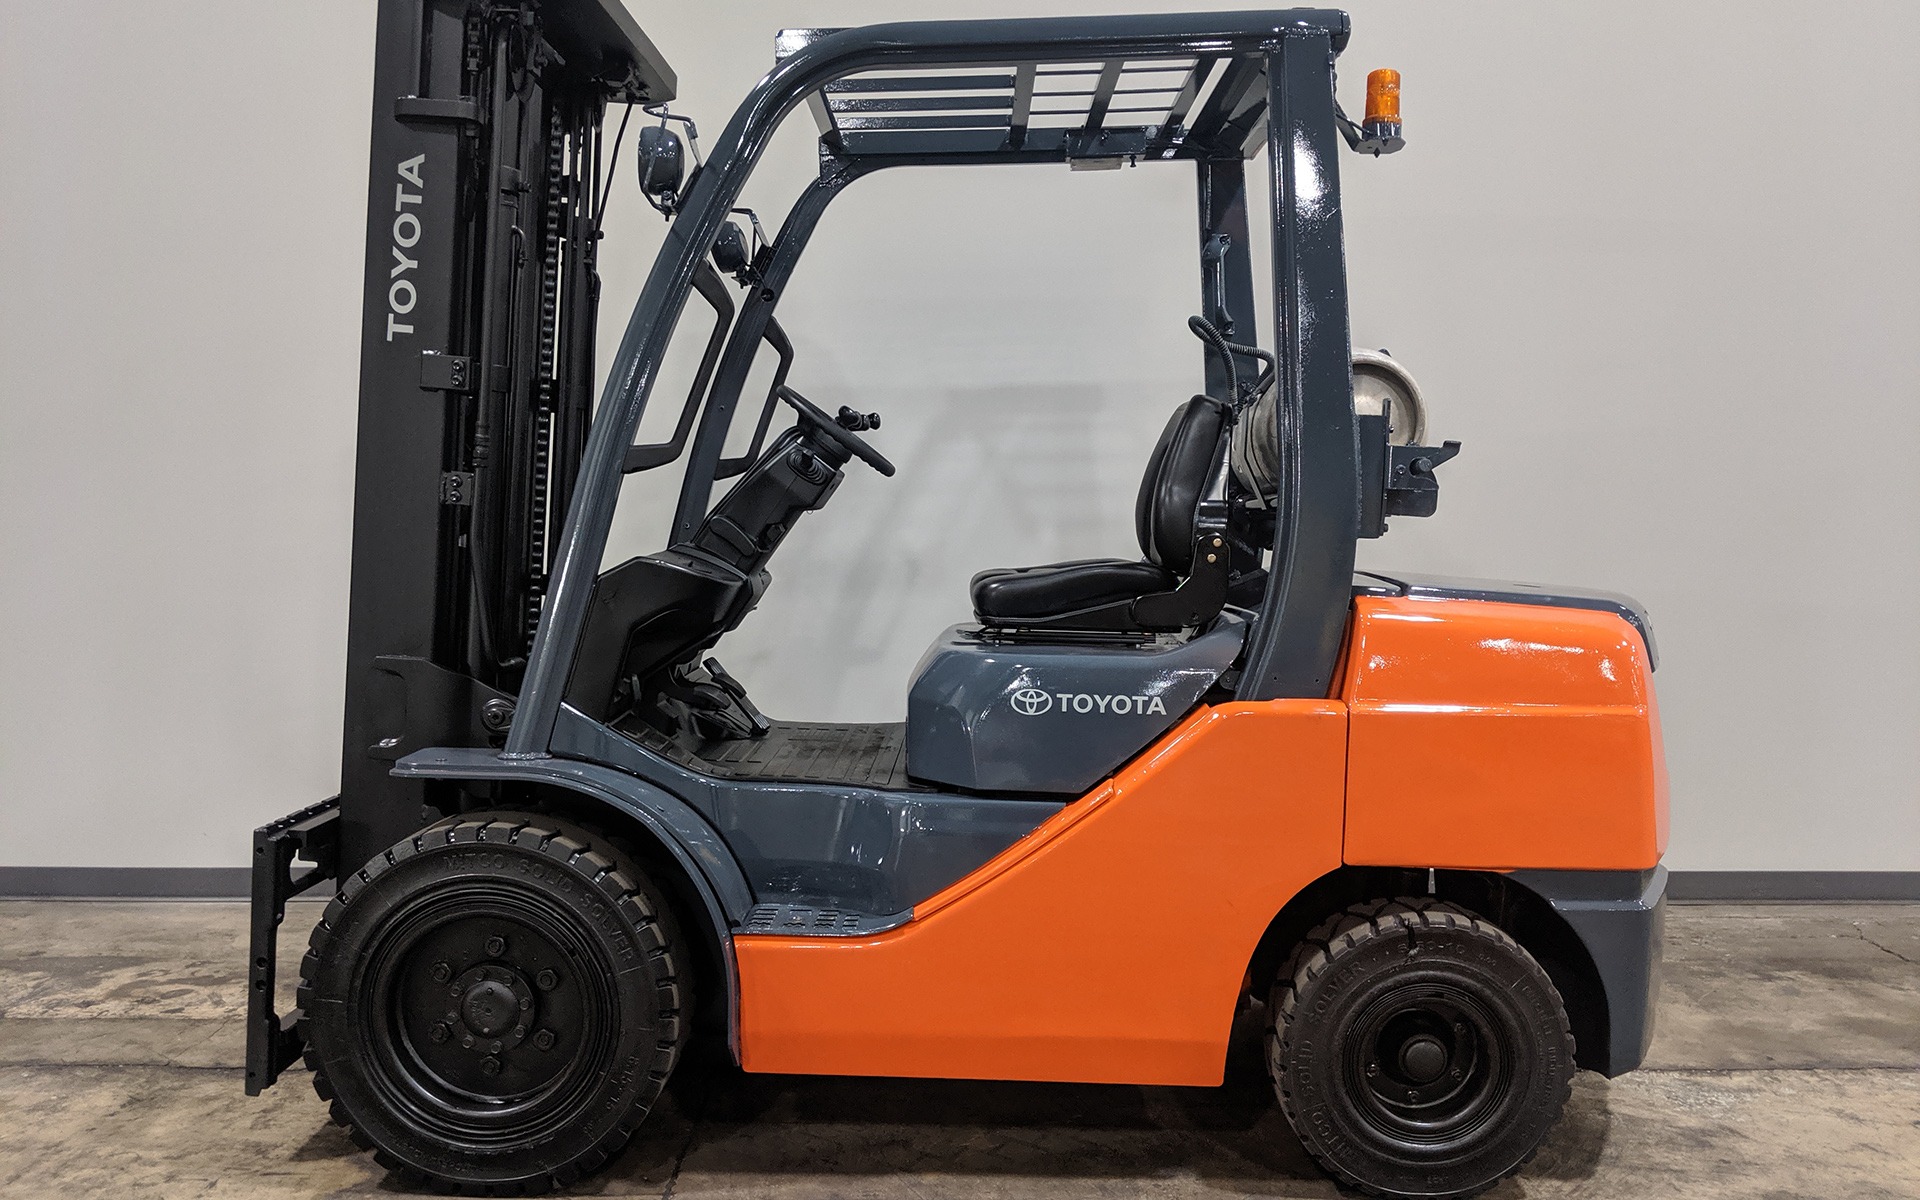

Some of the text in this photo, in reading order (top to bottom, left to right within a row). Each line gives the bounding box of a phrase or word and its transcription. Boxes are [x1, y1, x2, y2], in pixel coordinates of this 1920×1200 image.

[386, 153, 426, 342] TOYOTA
[1056, 693, 1167, 715] TOYOTA
[518, 858, 575, 893] SOLID
[580, 893, 635, 962] SOLVER
[1307, 962, 1365, 1025] SOLVER
[1297, 1040, 1319, 1097] SOLID
